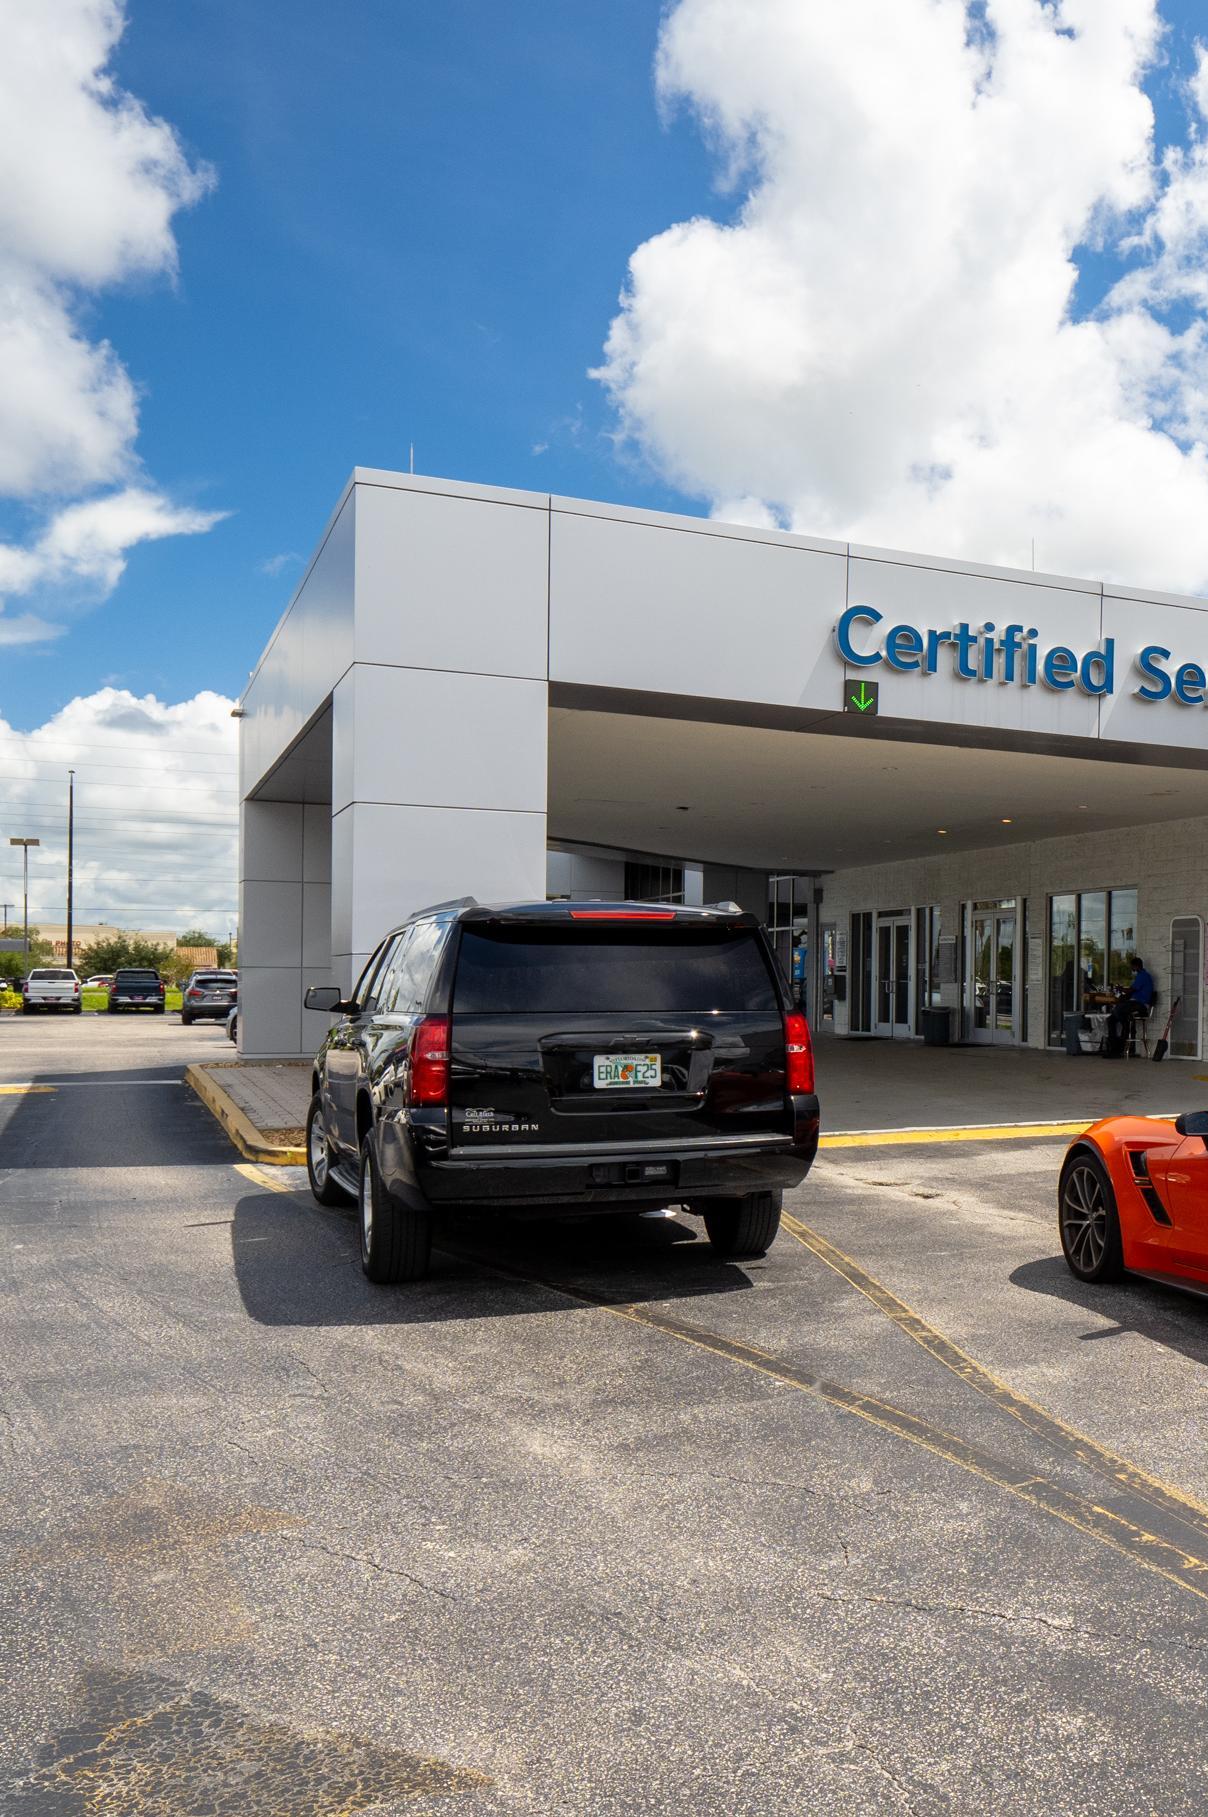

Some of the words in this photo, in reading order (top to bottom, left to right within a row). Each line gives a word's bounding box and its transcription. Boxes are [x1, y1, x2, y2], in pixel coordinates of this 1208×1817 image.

[835, 604, 1115, 697] Certified
[597, 1064, 620, 1081] ERA
[634, 1063, 657, 1079] F25
[462, 1124, 539, 1132] SUBURBAN
